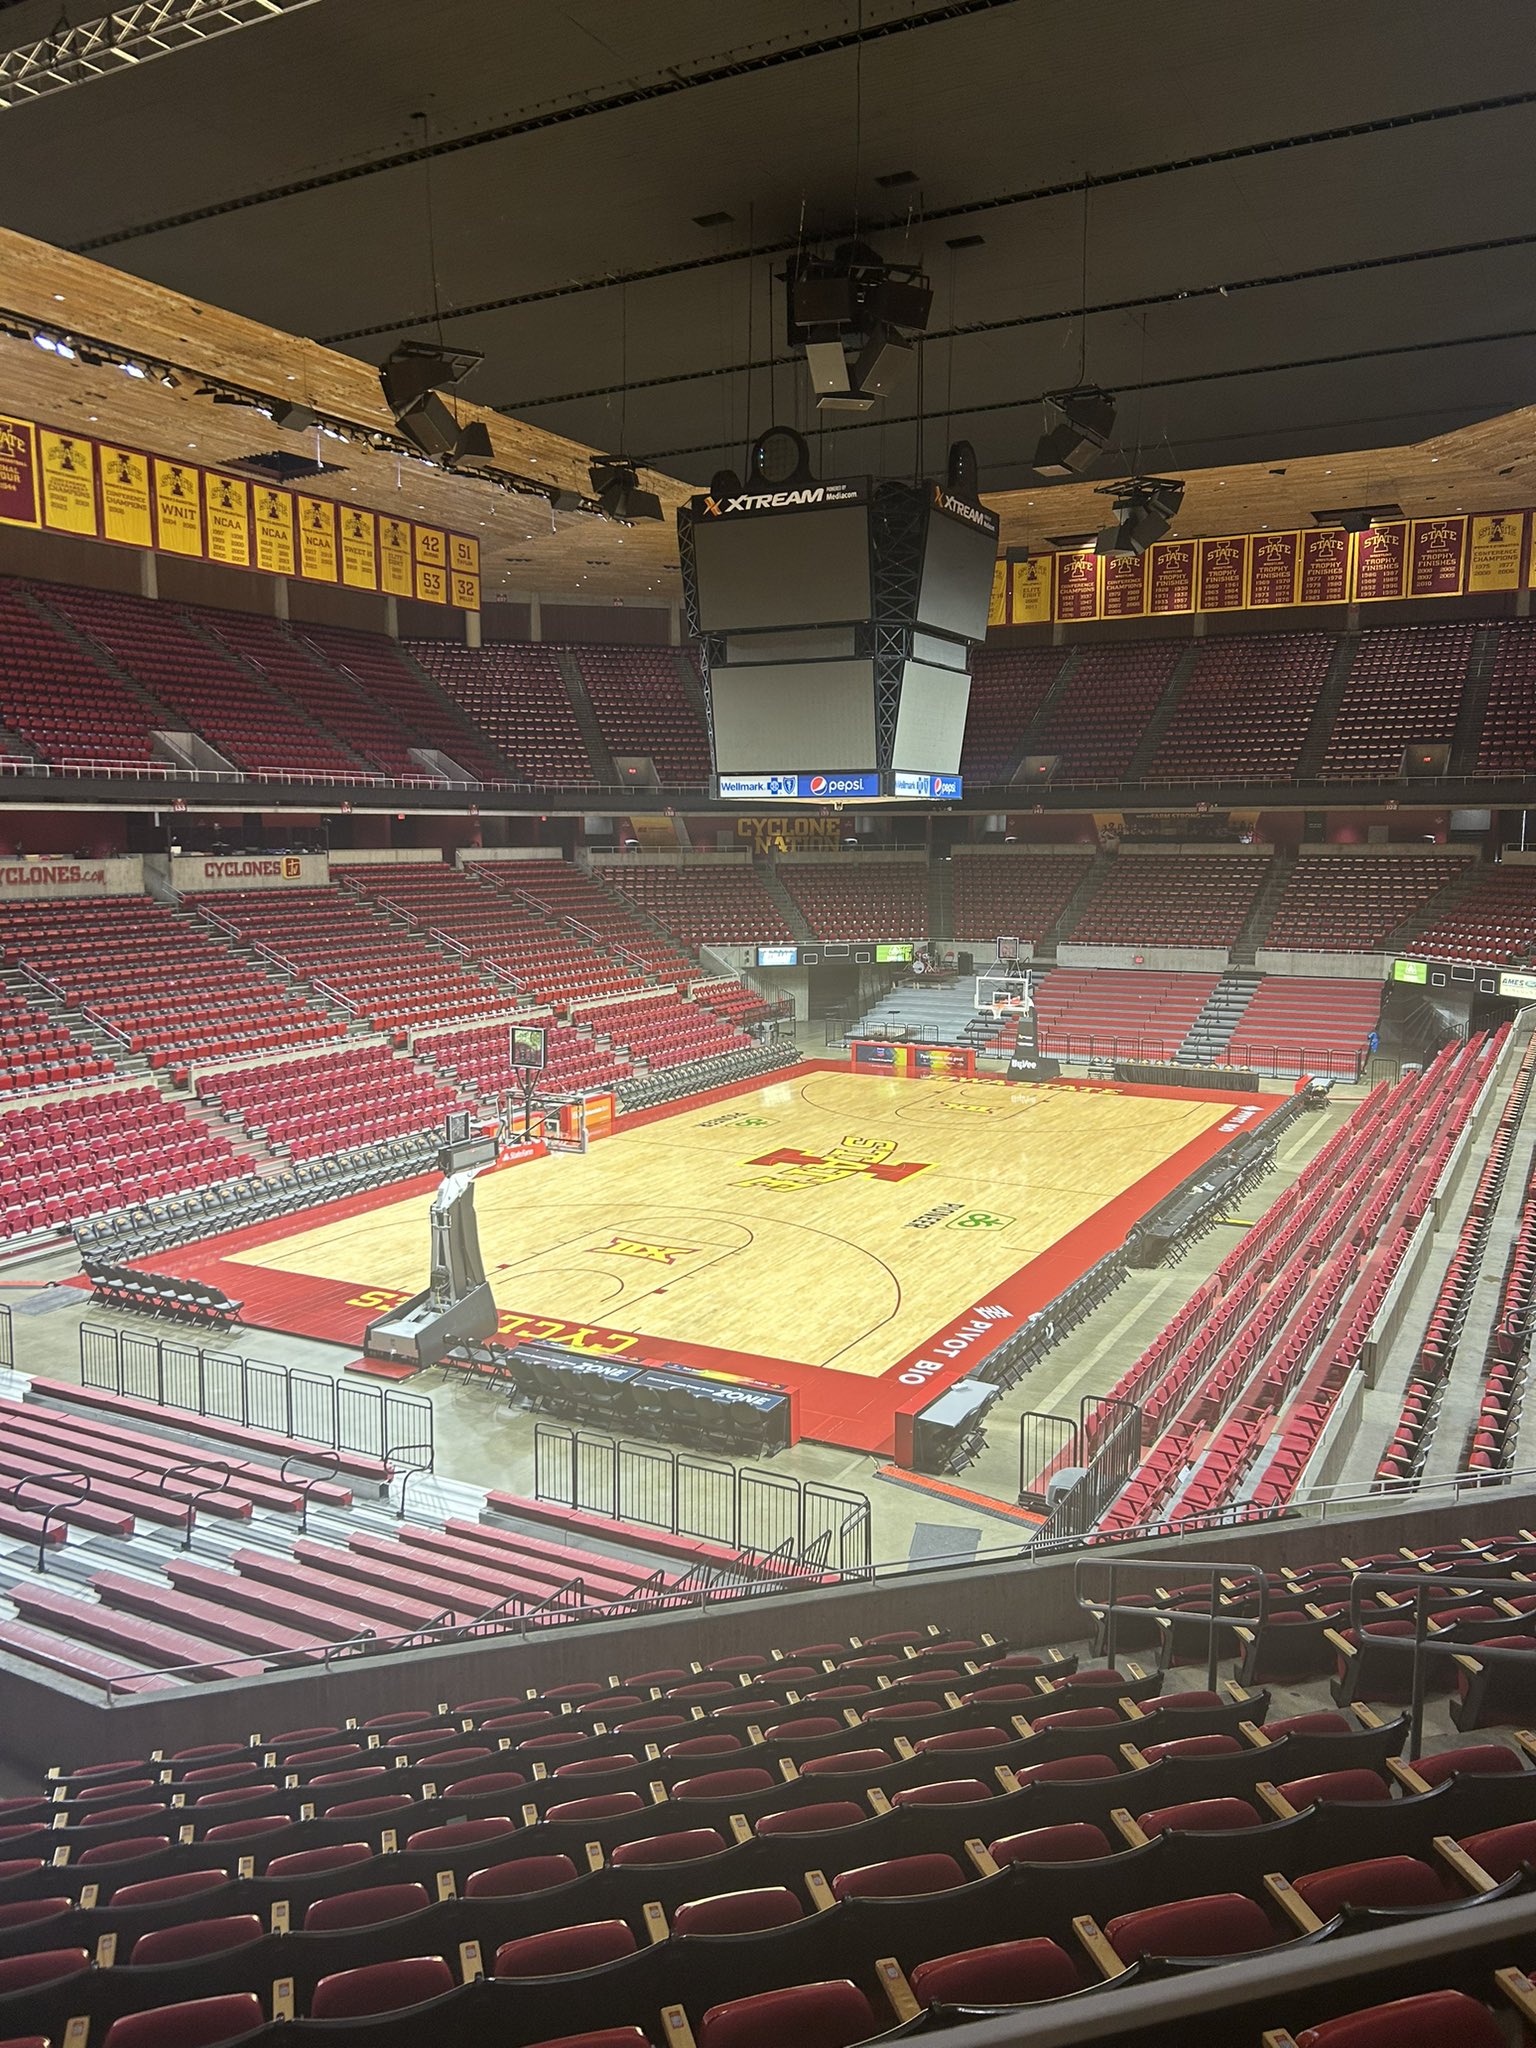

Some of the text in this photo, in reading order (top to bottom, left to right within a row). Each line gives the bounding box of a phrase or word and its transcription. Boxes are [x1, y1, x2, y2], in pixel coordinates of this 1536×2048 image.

[0, 432, 26, 453] ATE
[0, 471, 21, 483] OUR
[725, 487, 825, 513] XTREAM
[826, 491, 857, 501] Mediacom
[162, 503, 196, 520] WNIT
[944, 495, 983, 526] XTREAM
[214, 516, 242, 530] NCAA
[262, 526, 288, 540] NCAA
[1420, 530, 1457, 543] STATE
[1478, 525, 1517, 539] STATE
[307, 536, 331, 549] NCAA
[422, 536, 439, 552] 42
[1310, 540, 1344, 552] STATE
[1364, 535, 1399, 549] STATE
[458, 543, 471, 560] 51
[1207, 549, 1239, 562] STATE
[1258, 543, 1291, 557] STATE
[1474, 549, 1518, 557] CONFERENCE
[1110, 556, 1140, 569] STATE
[1158, 552, 1189, 566] STATE
[1365, 557, 1396, 565] TROPHY
[1418, 559, 1456, 567] FINISHES
[1473, 555, 1518, 563] CHAMPIONS
[1064, 561, 1093, 574] STATE
[1362, 563, 1399, 571] FINISHES
[424, 573, 440, 589] 53
[1206, 575, 1239, 583] FINISHES
[1256, 571, 1290, 579] FINISHES
[458, 580, 474, 596] 32
[1156, 579, 1189, 587] FINISHES
[1060, 587, 1095, 595] CHAMPIONS
[721, 778, 864, 793] Wellmark pepsi
[942, 782, 956, 794] pepsi
[737, 818, 840, 837] CYCLONE
[205, 861, 281, 878] CYCLONES
[1502, 978, 1524, 987] AMES
[1013, 1081, 1123, 1095] STATE
[728, 1135, 898, 1192] STATE
[898, 1320, 993, 1385] PIVOT BIO
[573, 1361, 629, 1378] ZONE
[712, 1388, 771, 1406] ZONE
